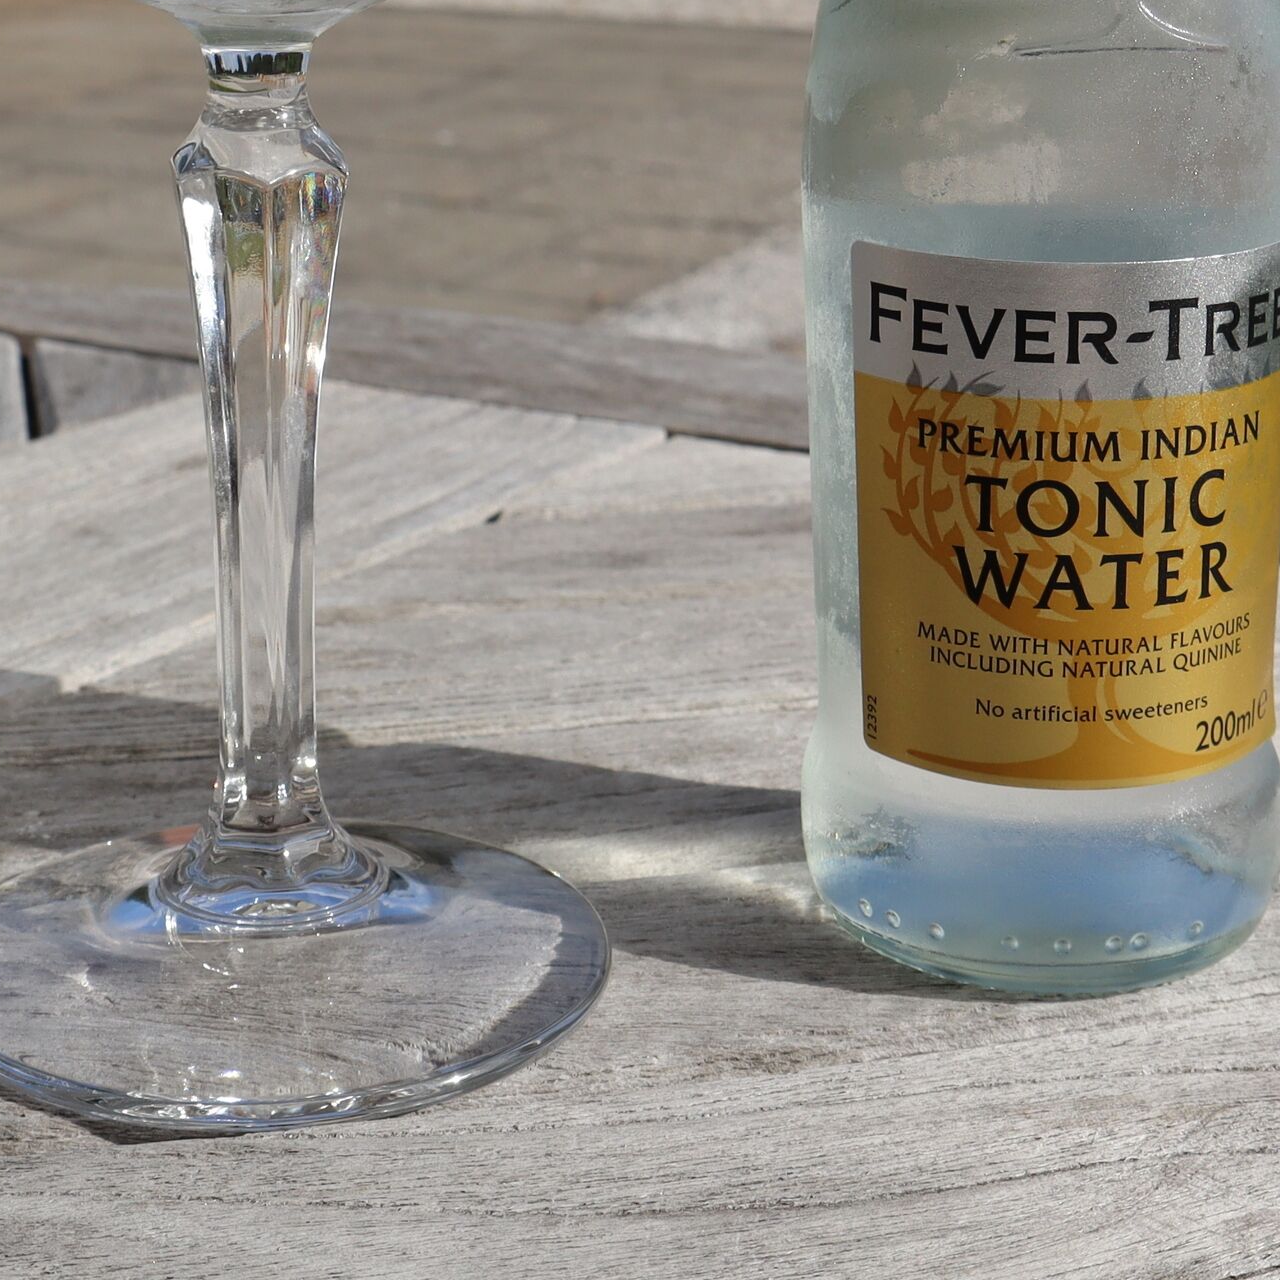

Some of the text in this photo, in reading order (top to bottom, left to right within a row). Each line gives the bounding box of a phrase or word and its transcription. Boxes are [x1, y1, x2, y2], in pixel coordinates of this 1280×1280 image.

[918, 410, 1260, 463] PREMIUM INDIAN
[964, 469, 1226, 538] TONIC
[952, 541, 1233, 611] WATER
[917, 612, 1251, 656] MADE WITH NATURAL FLAVOURS
[930, 637, 1242, 678] INCLUDING NATURAL QUININE
[866, 694, 878, 740] 12392
[975, 695, 1209, 722] No artificial sweeteners
